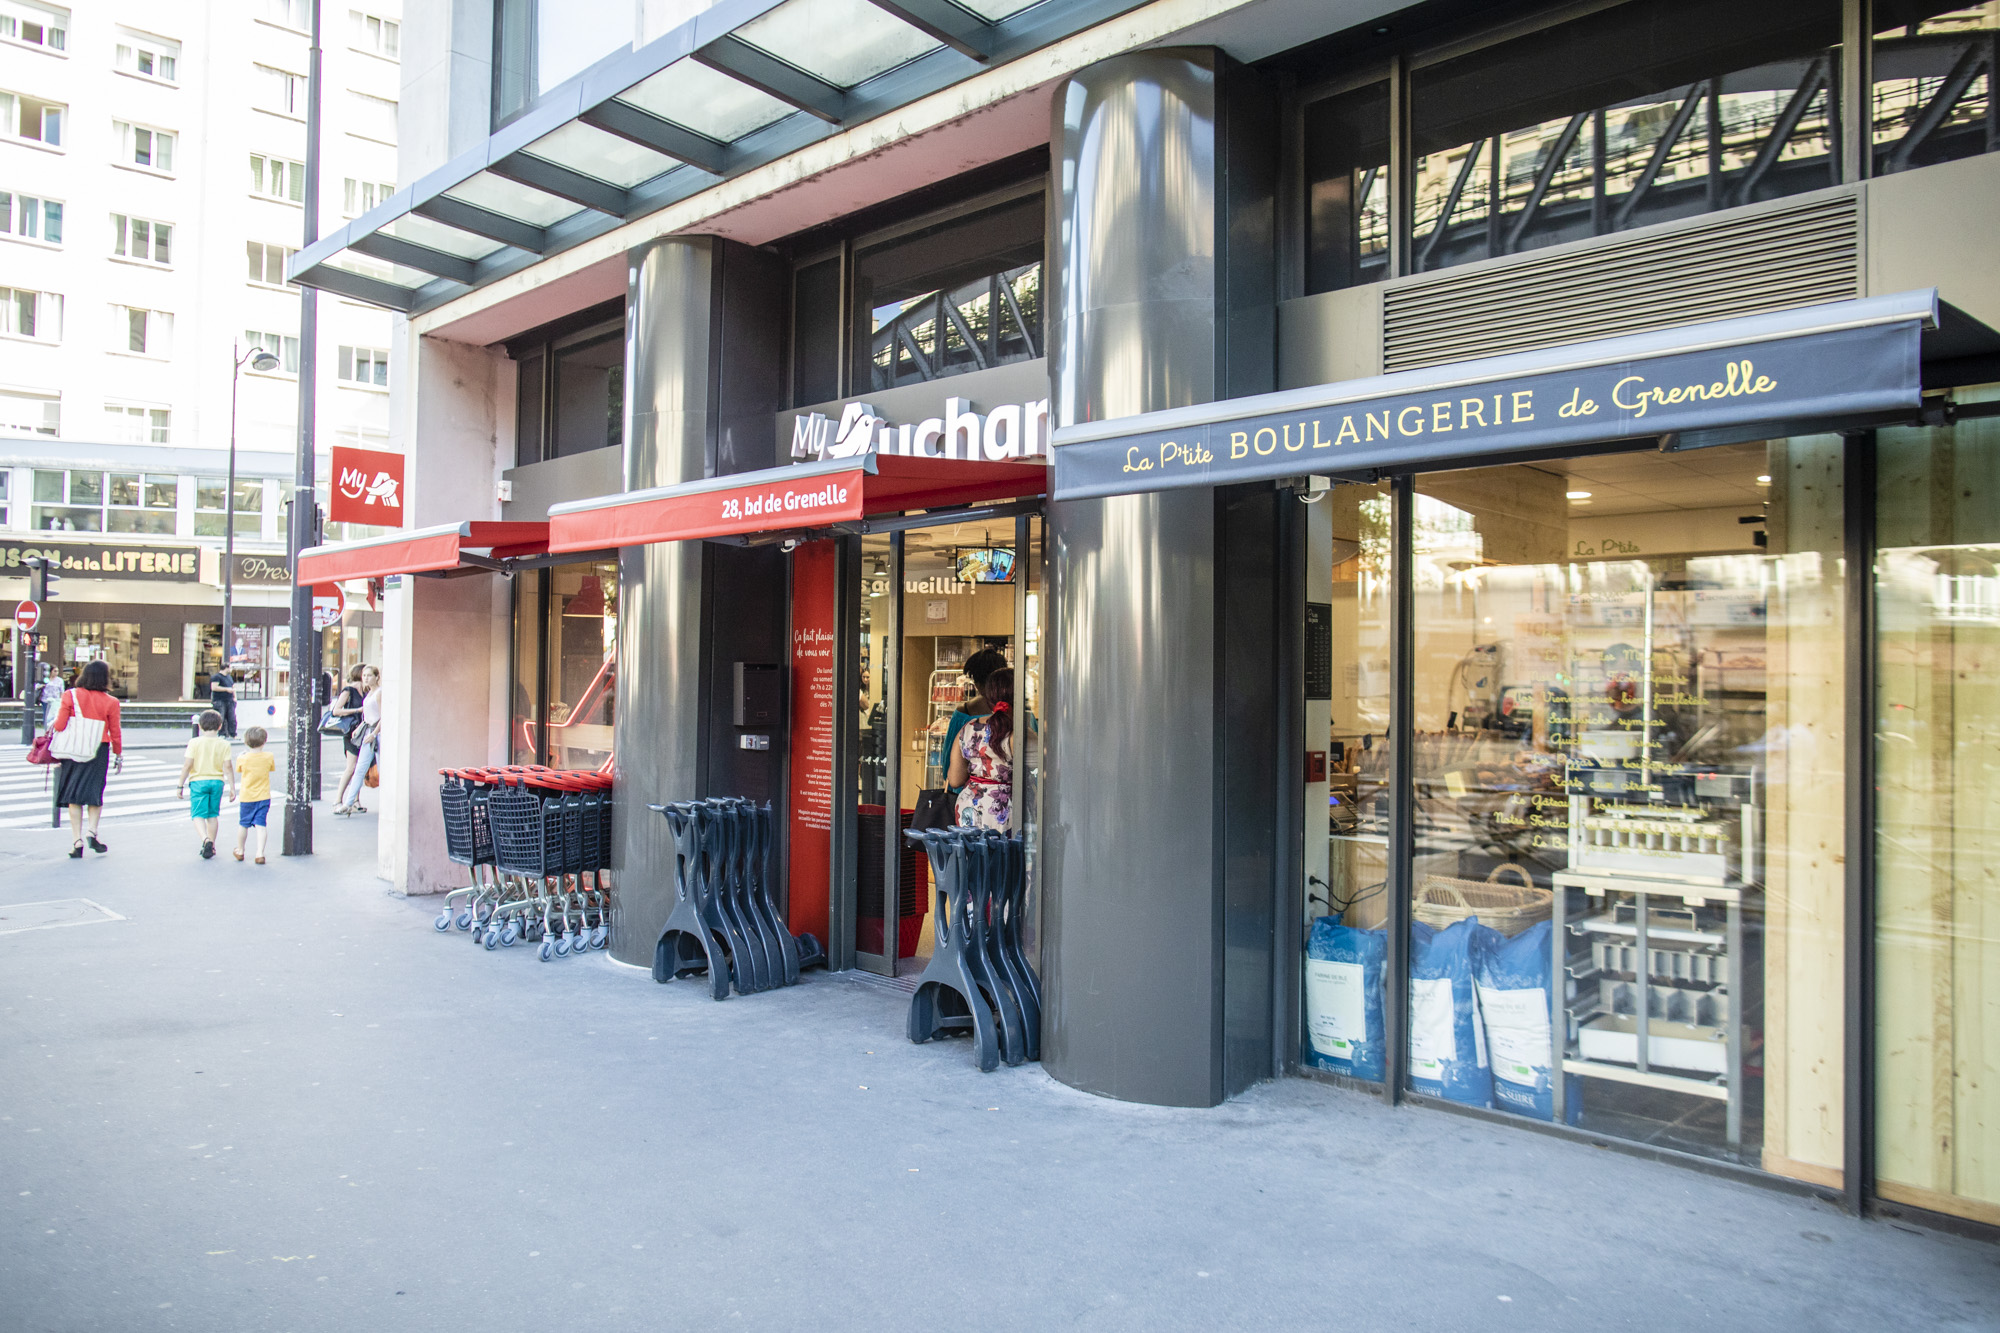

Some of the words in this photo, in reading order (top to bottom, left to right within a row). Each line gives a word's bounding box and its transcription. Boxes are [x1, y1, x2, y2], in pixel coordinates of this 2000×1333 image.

[1123, 446, 1154, 472] La
[1160, 441, 1213, 468] P'tite
[1230, 390, 1534, 460] BOULANGERIE
[1558, 387, 1599, 418] de
[1612, 360, 1778, 418] Grenelle
[790, 411, 837, 463] My
[339, 466, 367, 498] My
[722, 499, 742, 520] 28,
[744, 495, 762, 515] bd
[764, 494, 782, 513] de
[784, 484, 847, 510] Grenelle
[1574, 540, 1595, 555] La
[102, 550, 196, 574] LITERIE
[241, 558, 292, 580] Pres
[803, 628, 815, 644] fait
[797, 644, 803, 658] de
[819, 648, 830, 656] voir
